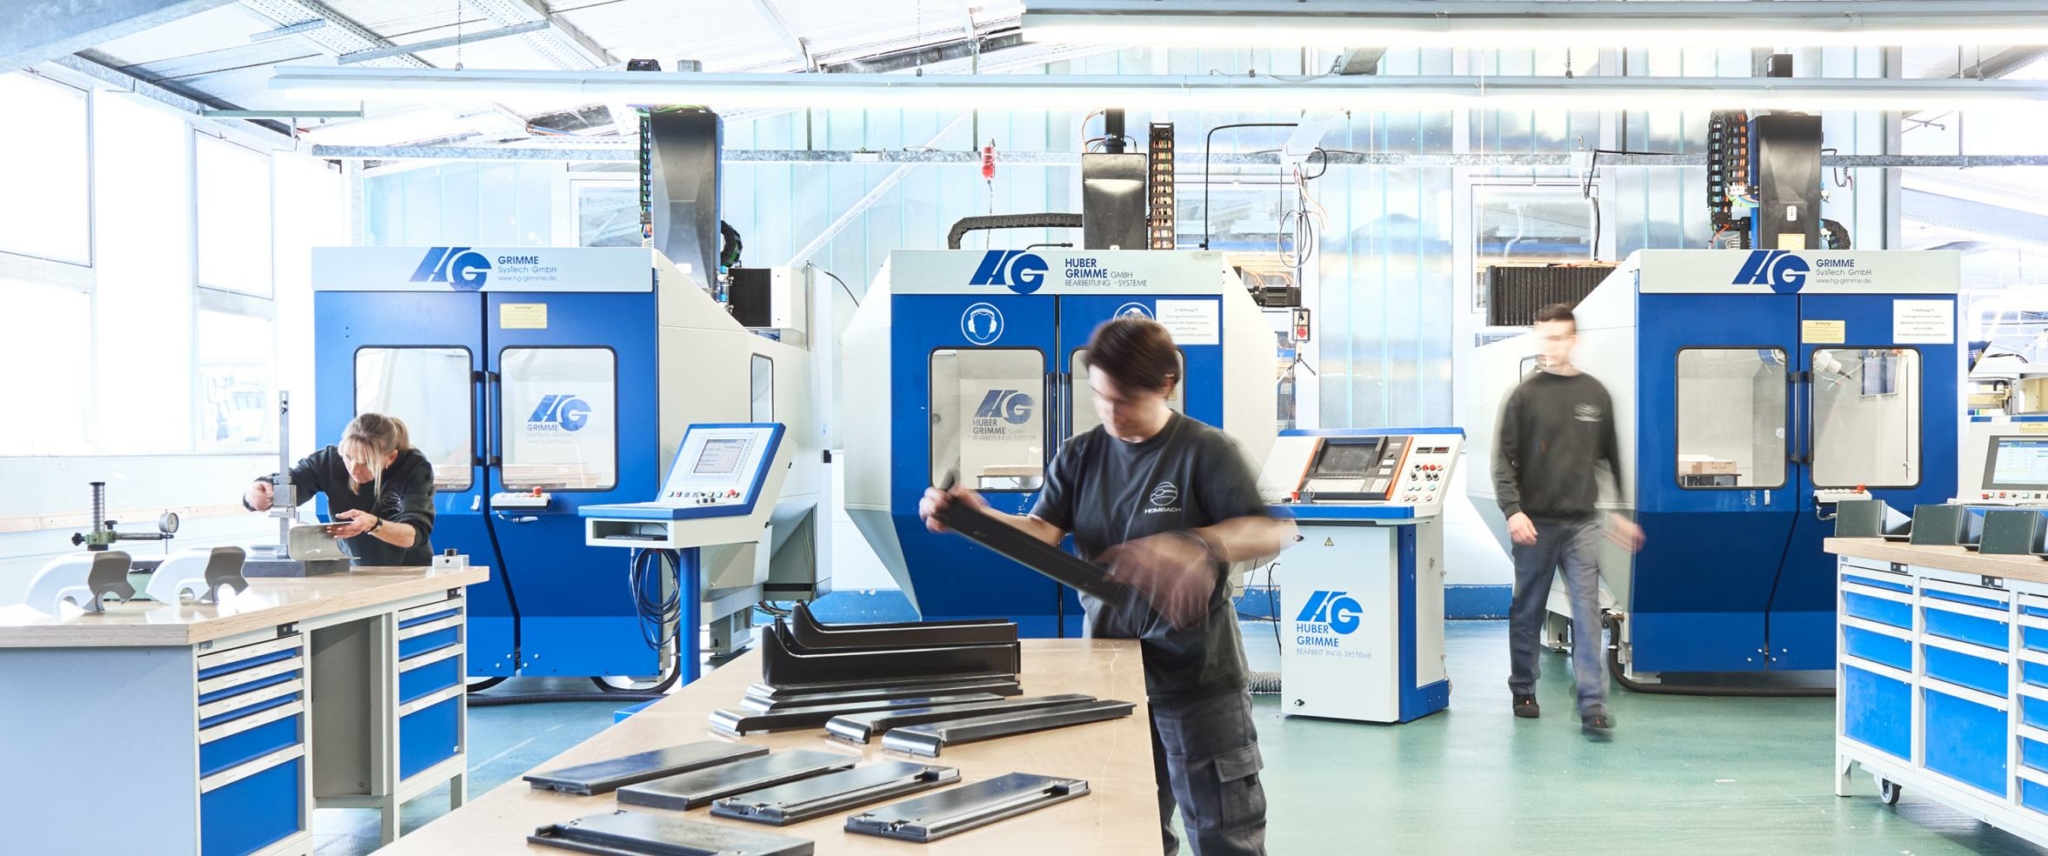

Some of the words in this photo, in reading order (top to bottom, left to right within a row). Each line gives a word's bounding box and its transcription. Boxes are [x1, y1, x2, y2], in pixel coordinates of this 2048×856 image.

[498, 256, 539, 265] GRIMME
[1065, 258, 1097, 267] HUBER
[1816, 259, 1855, 267] GRIMME
[498, 265, 529, 274] SysTech
[532, 265, 557, 273] GmbH
[1065, 269, 1108, 278] GRIMME
[1816, 268, 1846, 277] SysTech
[1848, 268, 1872, 276] GmbH
[972, 418, 998, 427] HUBER
[972, 427, 1006, 435] GRIMME
[1296, 623, 1329, 634] HUBER
[1296, 635, 1339, 648] GRIMME
